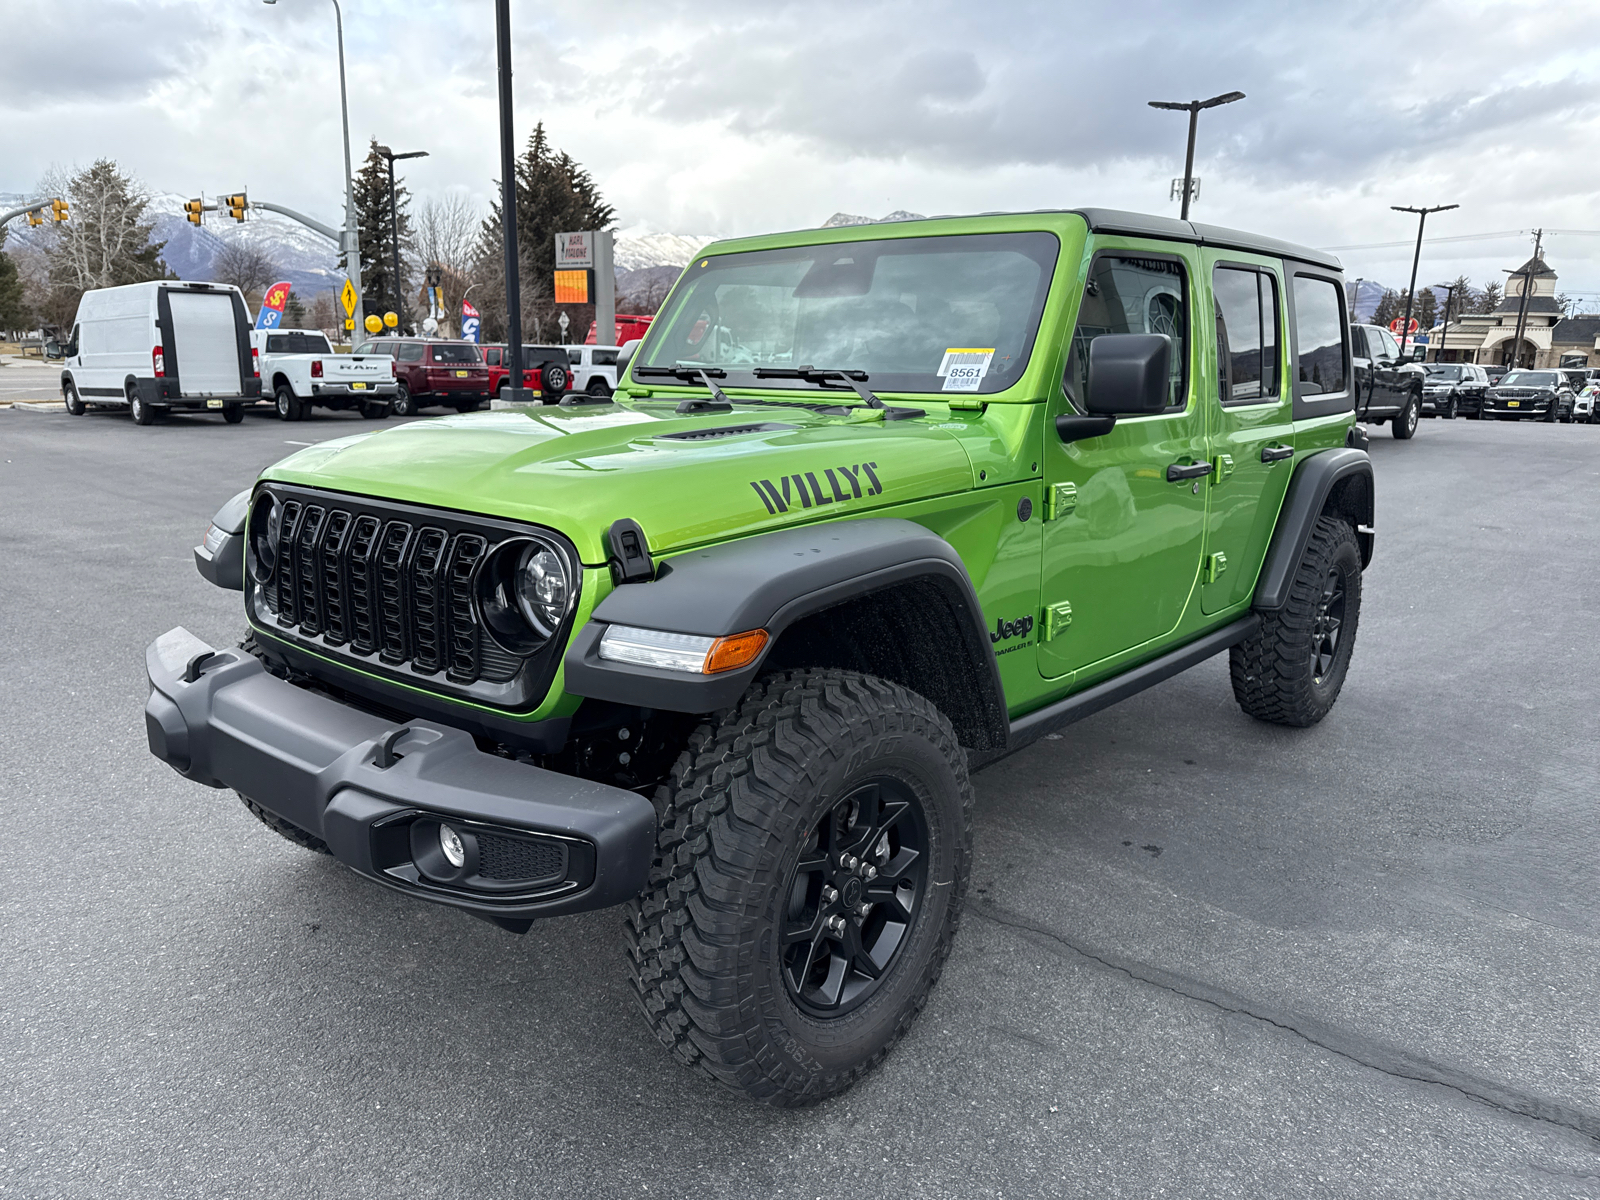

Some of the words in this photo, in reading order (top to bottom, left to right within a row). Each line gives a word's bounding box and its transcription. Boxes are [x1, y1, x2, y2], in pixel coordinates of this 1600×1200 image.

[263, 311, 277, 329] S
[950, 368, 981, 378] 8561
[749, 461, 883, 515] WILLYS
[990, 614, 1034, 643] Jeep
[994, 641, 1027, 657] RANGLER
